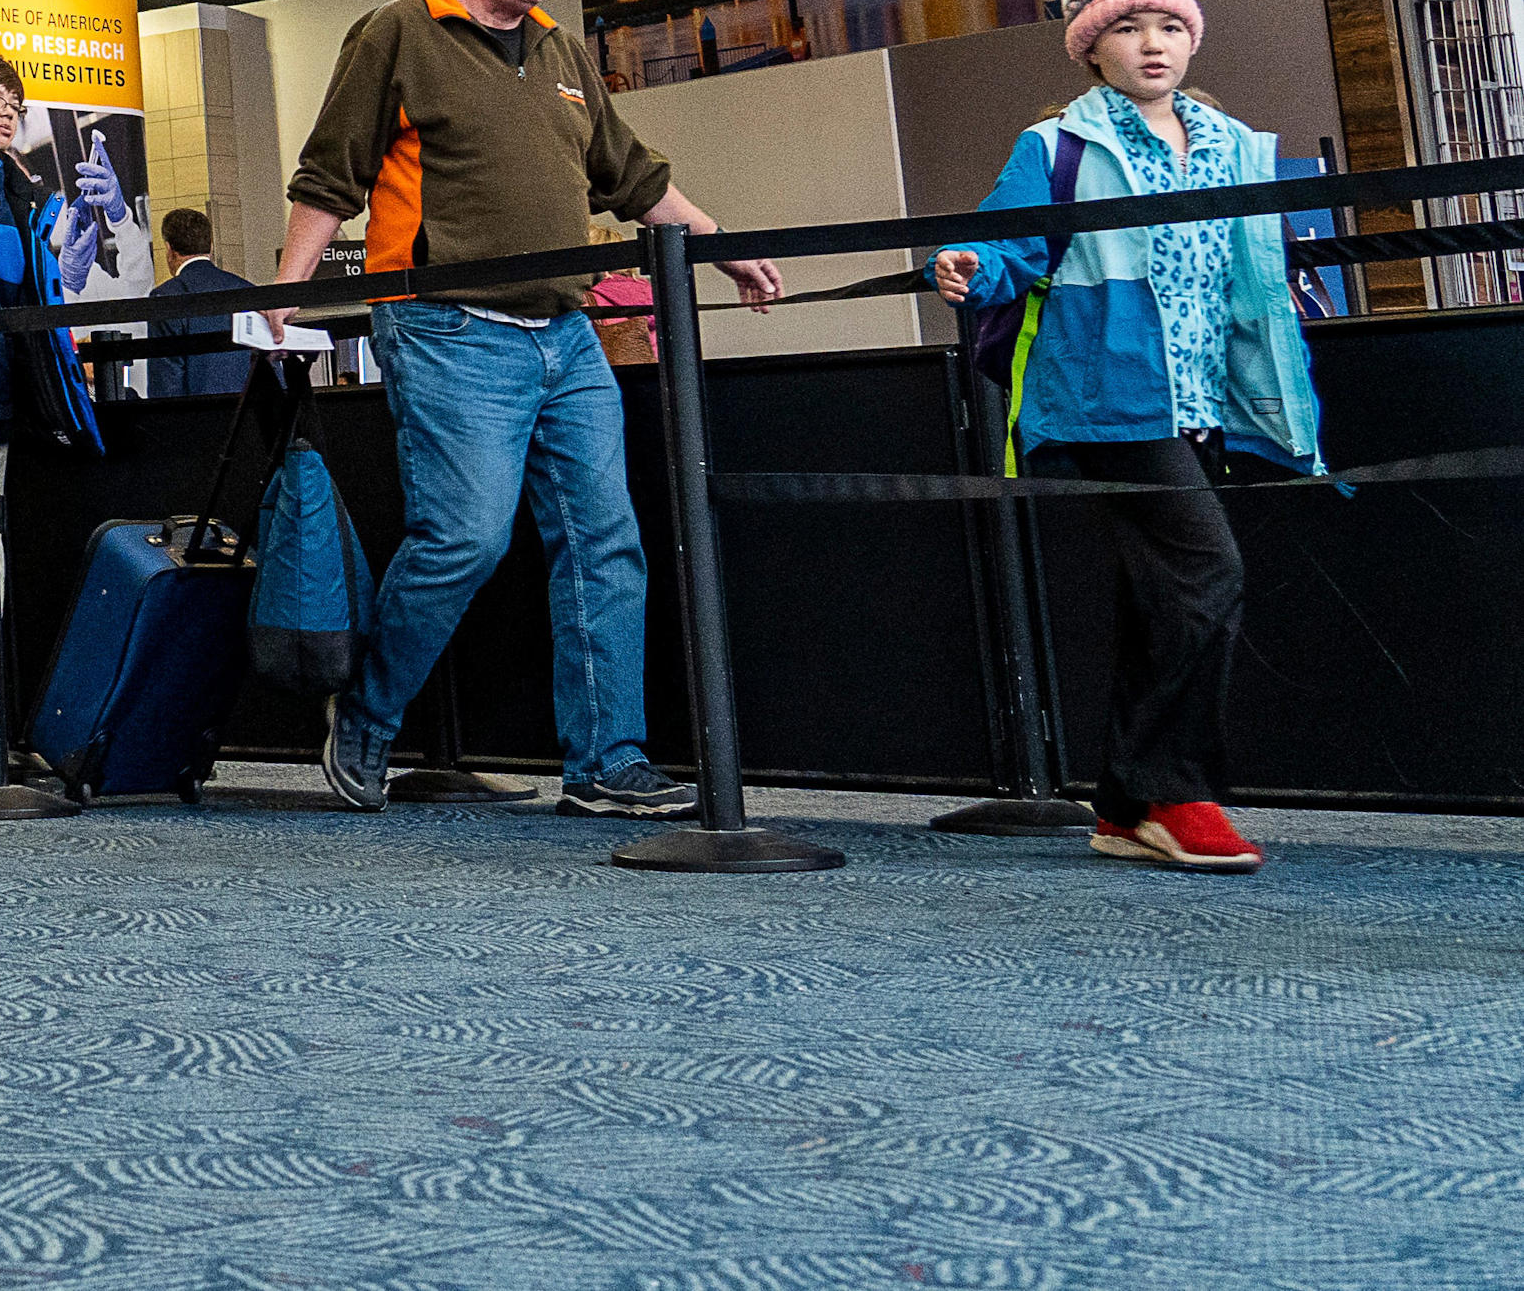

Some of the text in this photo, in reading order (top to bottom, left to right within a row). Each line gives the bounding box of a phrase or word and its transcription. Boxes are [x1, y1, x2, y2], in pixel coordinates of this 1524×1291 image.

[25, 9, 43, 26] OF
[47, 13, 123, 35] AMERICA'S
[32, 34, 125, 61] RESEARCH
[8, 60, 126, 87] NIVERSITIES
[321, 247, 367, 261] Elevat
[345, 263, 361, 276] to
